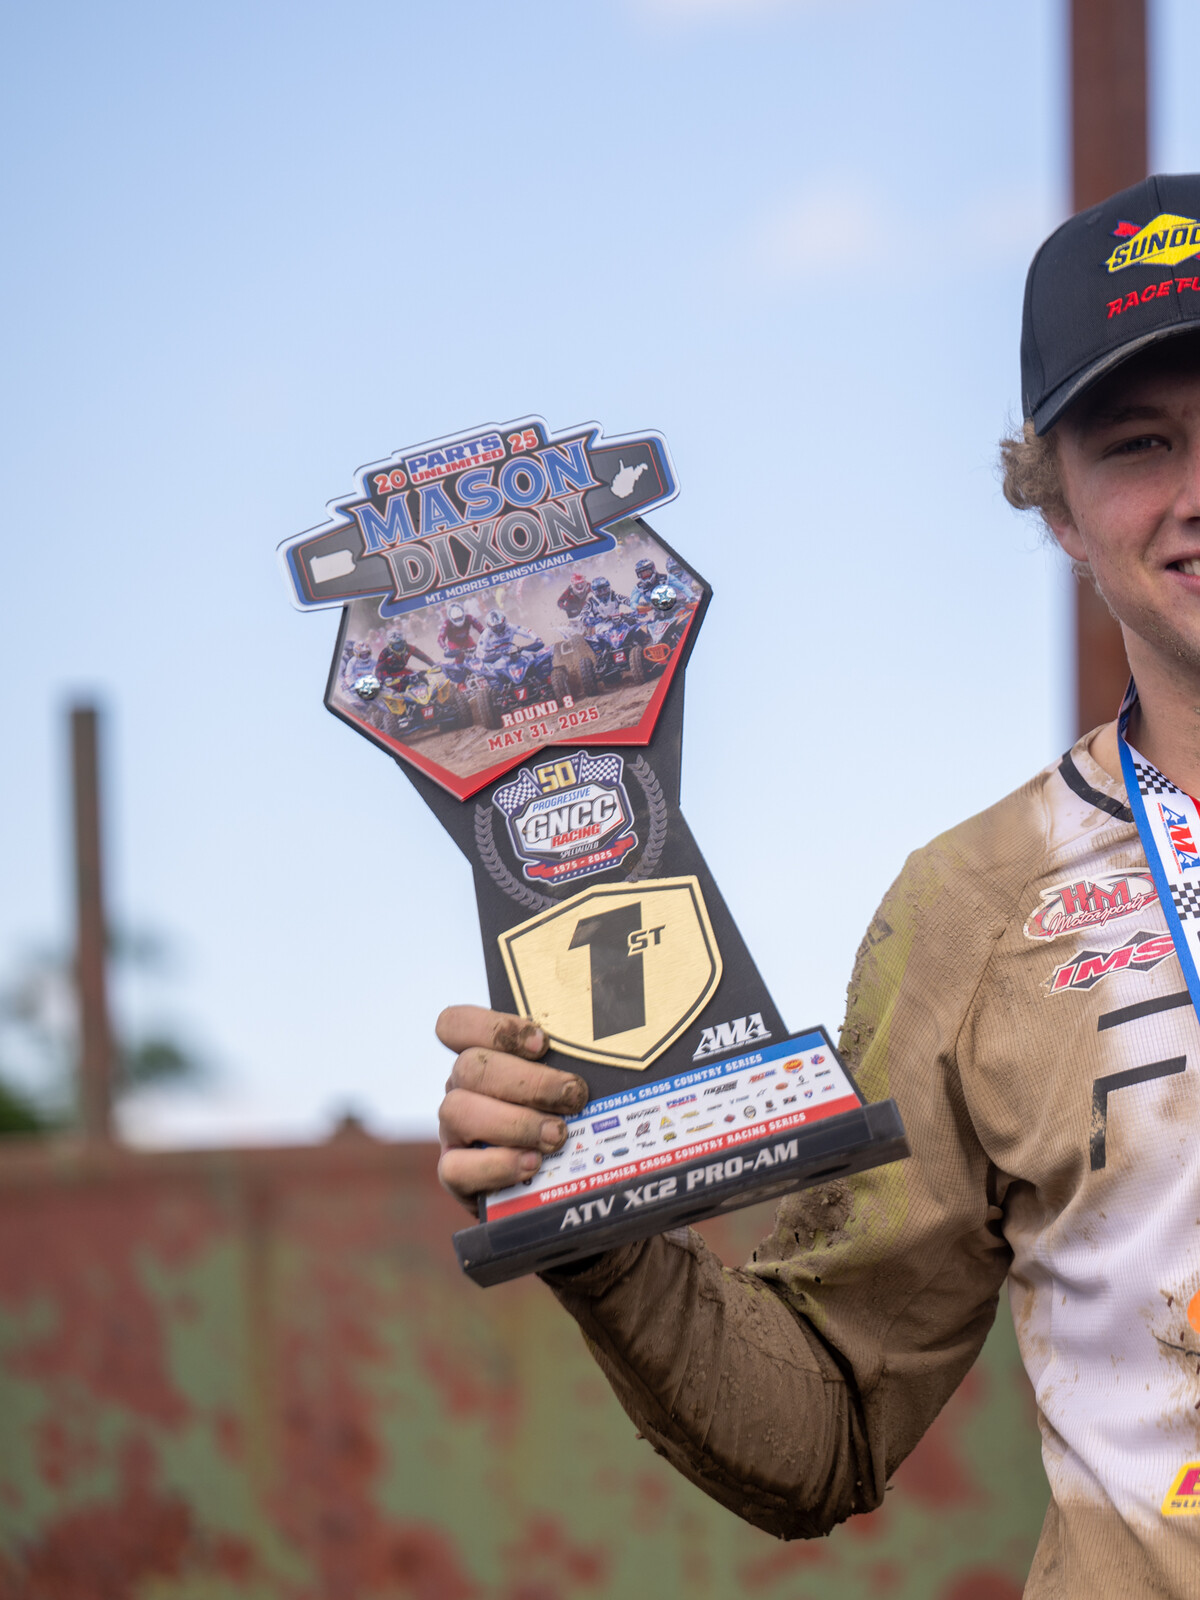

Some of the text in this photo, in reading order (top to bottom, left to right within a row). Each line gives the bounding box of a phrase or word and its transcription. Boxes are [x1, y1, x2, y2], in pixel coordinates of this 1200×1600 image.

[1107, 280, 1174, 320] RACE
[407, 433, 501, 474] PARTS
[507, 428, 539, 454] 25
[373, 468, 408, 494] 20
[411, 447, 504, 483] UNLIMITED
[352, 437, 597, 554] MASON
[383, 492, 596, 600] DIXON
[424, 551, 574, 604] MT. MORRIS PENNSYLVANIA
[487, 706, 599, 750] MAY 31, 2025
[501, 694, 574, 728] ROUND 8
[520, 792, 619, 844] GNCC
[531, 787, 591, 812] PROGRESSIVE
[550, 823, 601, 847] RACING
[552, 860, 577, 874] 1975
[587, 849, 612, 863] 2025
[1050, 893, 1156, 938] Motorsports
[1054, 935, 1176, 990] IMS
[692, 1012, 770, 1056] AMA
[580, 1091, 636, 1117] NATIONAL
[638, 1080, 671, 1099] CROSS
[673, 1064, 722, 1088] COUNTRY
[724, 1052, 763, 1072] SERIES
[539, 1178, 587, 1202] WORLD'S
[589, 1163, 637, 1186] PREMIER
[639, 1153, 672, 1171] CROSS
[674, 1137, 724, 1160] COUNTRY
[726, 1123, 766, 1143] RACING
[767, 1111, 806, 1131] SERIES
[559, 1140, 799, 1230] ATV XC2 PRO-AM
